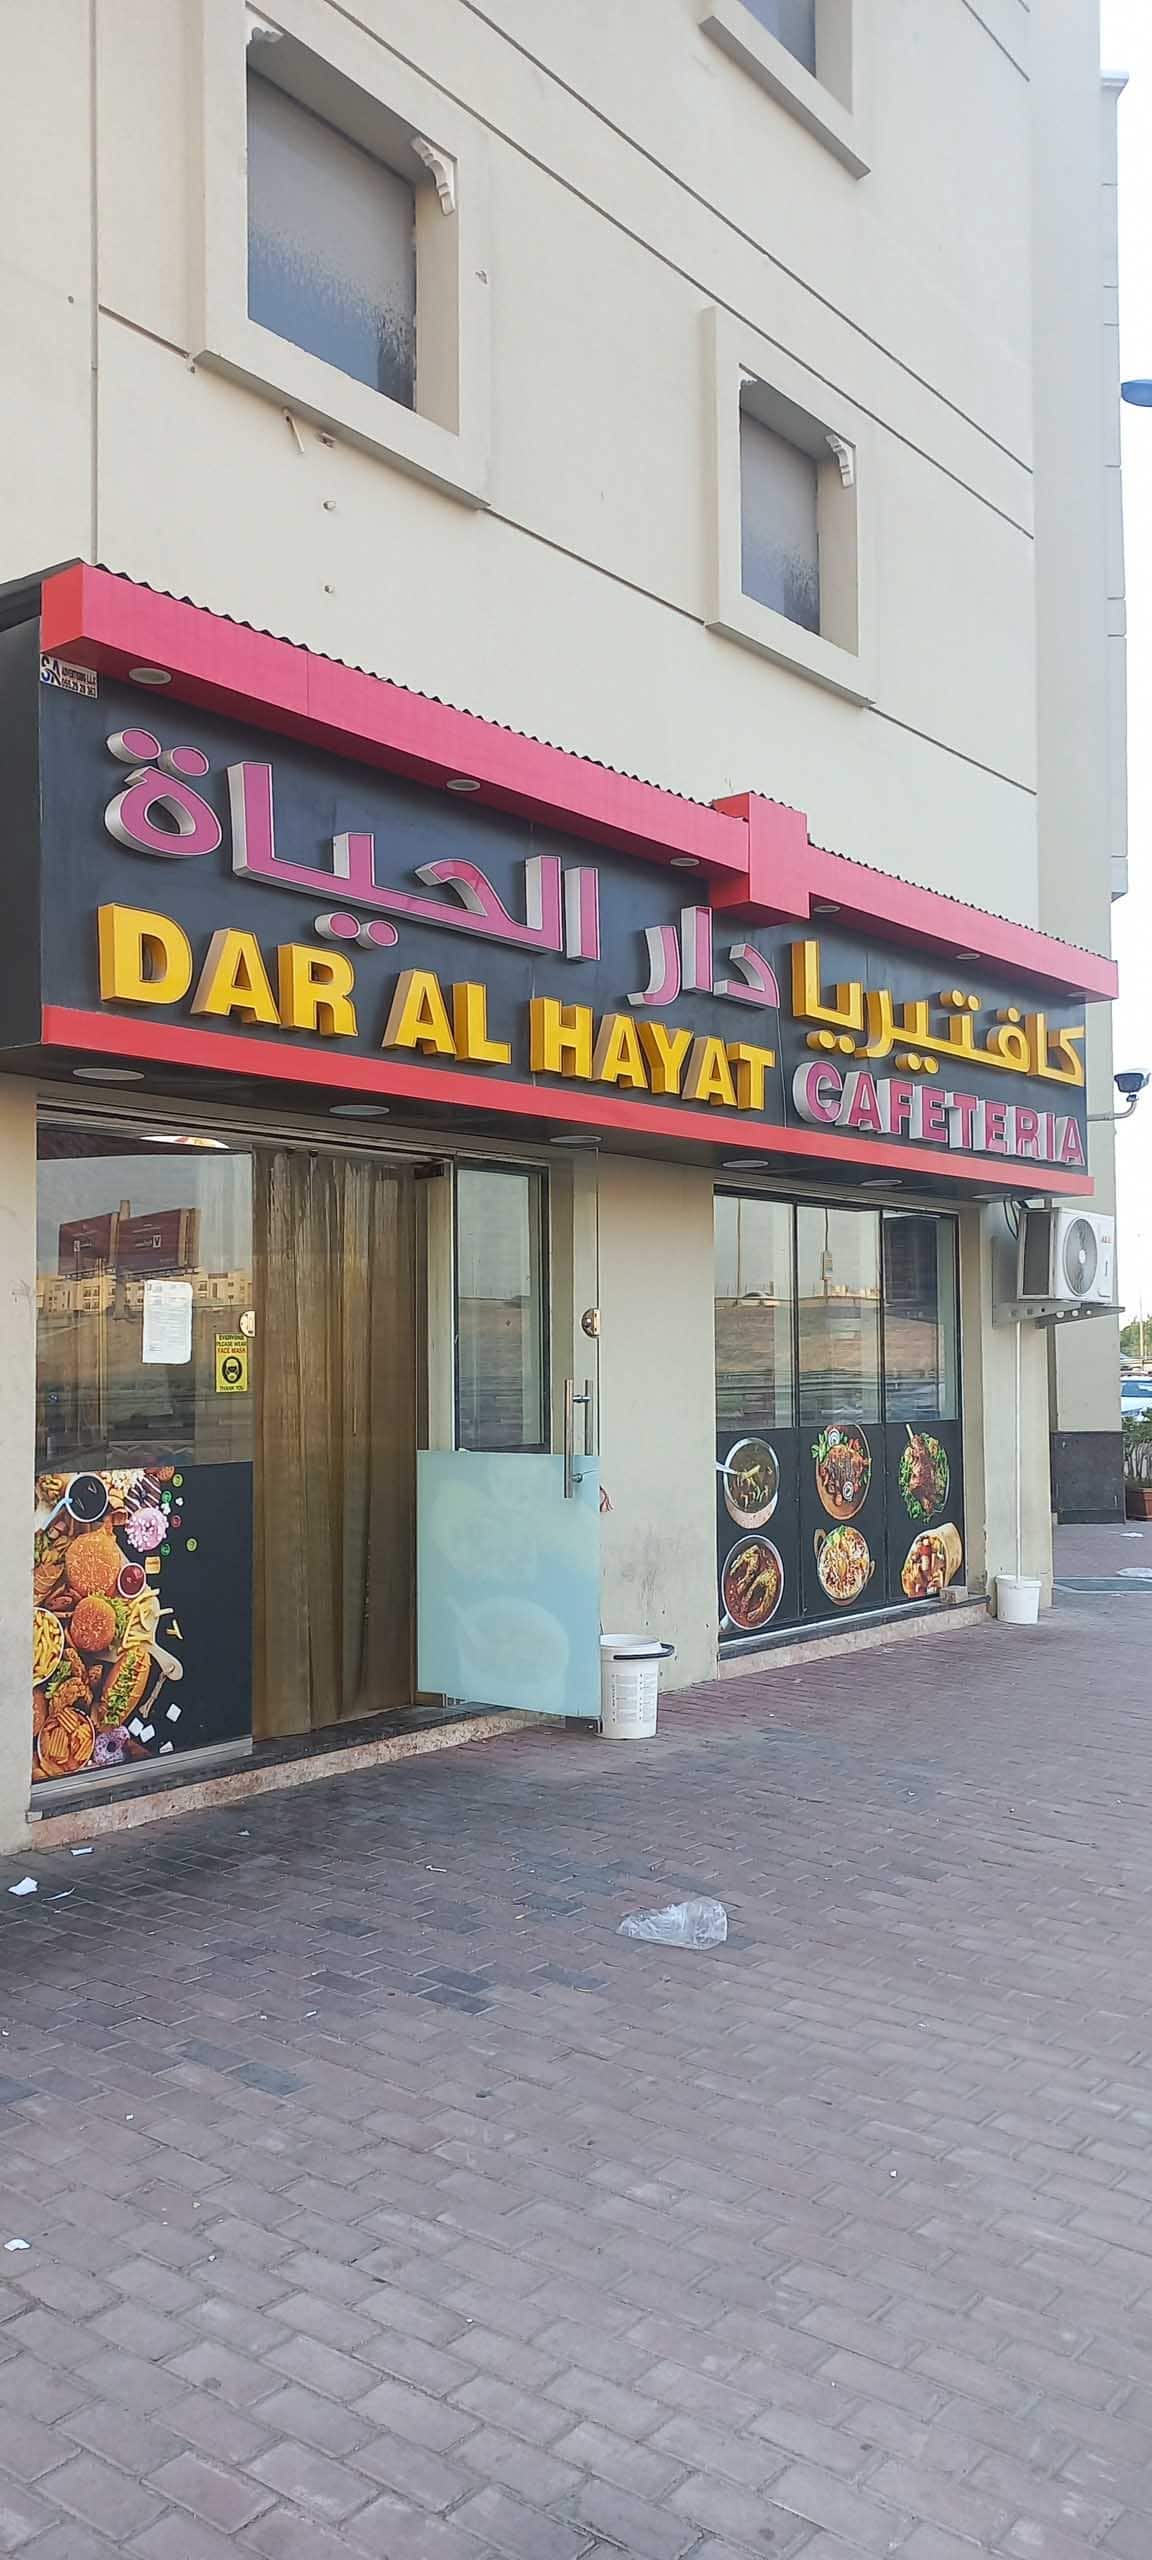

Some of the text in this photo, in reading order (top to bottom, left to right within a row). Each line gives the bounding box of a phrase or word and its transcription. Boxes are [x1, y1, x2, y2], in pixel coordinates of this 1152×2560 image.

[103, 727, 780, 1008] دار الحياة
[97, 903, 776, 1111] DAR AL HAYAT
[791, 939, 1086, 1087] كافتيريا
[792, 1060, 1086, 1168] CAFETERIA
